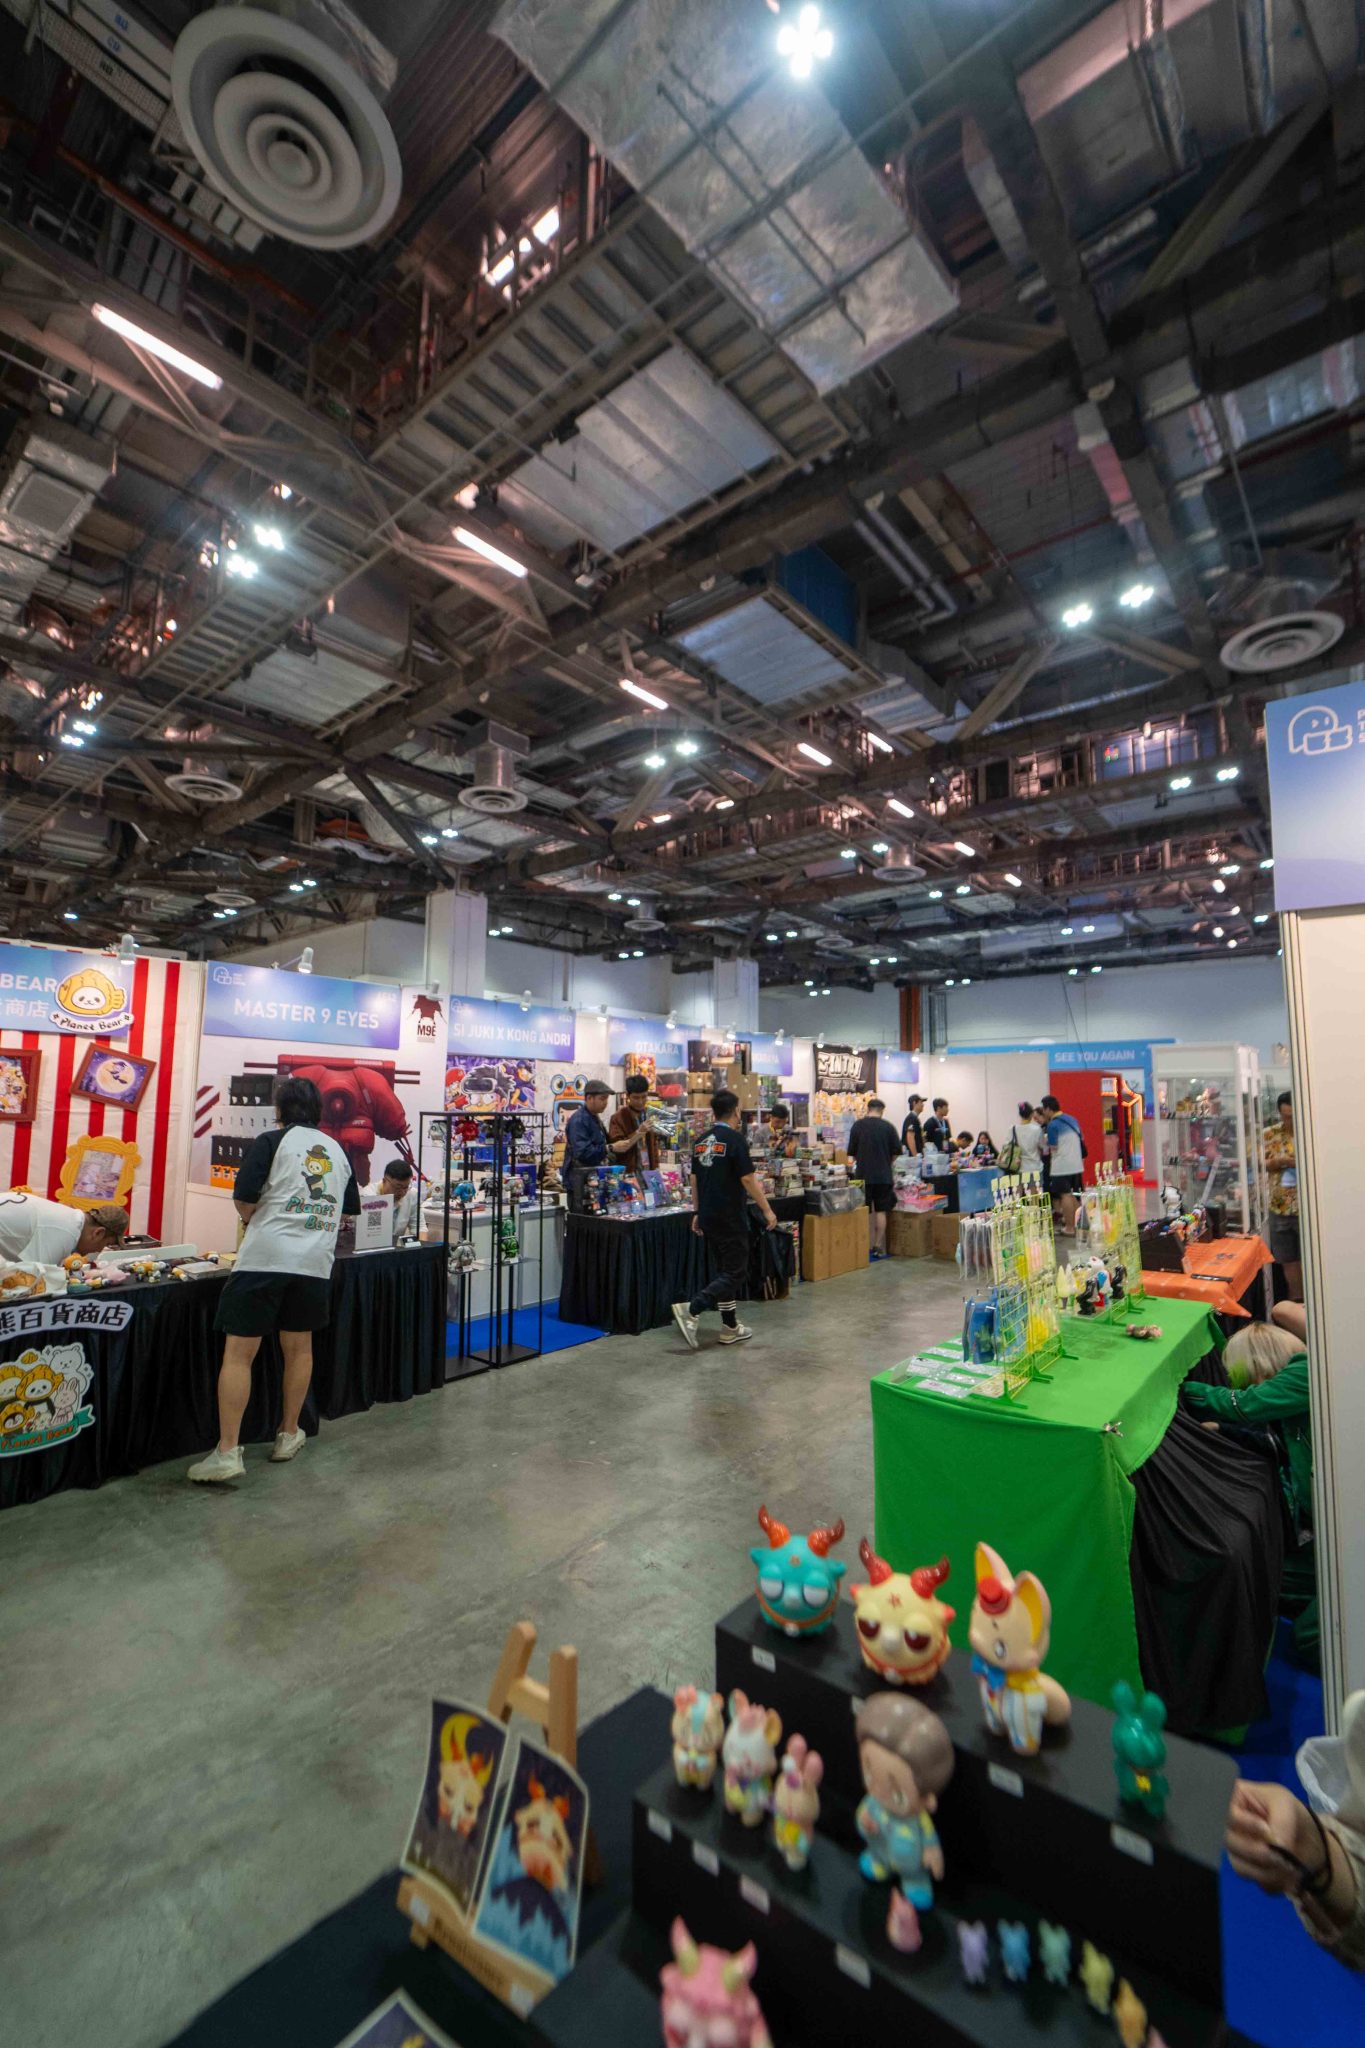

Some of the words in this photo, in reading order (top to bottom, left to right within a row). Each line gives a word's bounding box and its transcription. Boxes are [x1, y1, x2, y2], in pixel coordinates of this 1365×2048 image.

[0, 973, 56, 992] BEAR
[0, 996, 50, 1018] 商店
[233, 998, 316, 1023] MASTER
[320, 1008, 331, 1024] 9
[336, 1010, 380, 1029] EYES
[60, 1017, 95, 1031] Planet
[99, 1019, 122, 1030] Bear
[417, 1024, 437, 1038] M9E
[454, 1023, 465, 1037] SI
[467, 1024, 495, 1040] JUKI
[496, 1027, 506, 1040] X
[507, 1028, 537, 1043] KONG
[539, 1031, 571, 1047] ANDRI
[1054, 1051, 1075, 1063] SEE
[1077, 1050, 1099, 1062] YOU
[1100, 1049, 1135, 1061] AGAIN
[286, 1196, 336, 1218] Planet
[304, 1214, 337, 1232] Bear
[1, 1434, 43, 1451] Planet
[46, 1424, 74, 1441] Bear
